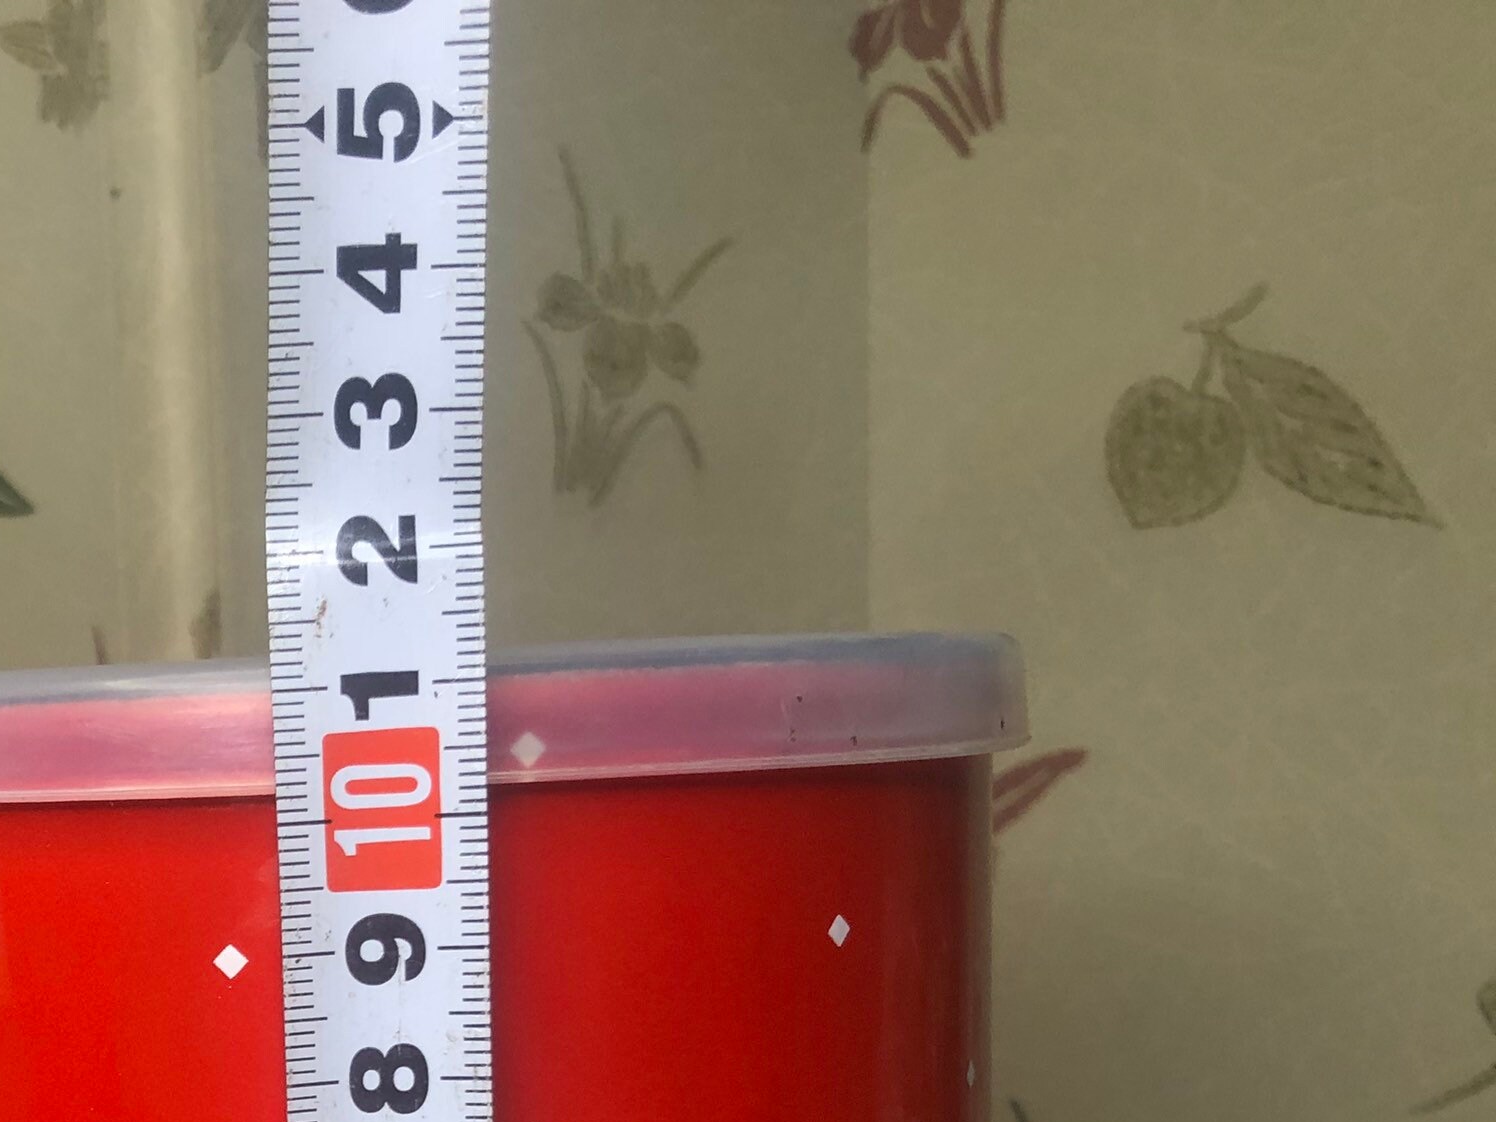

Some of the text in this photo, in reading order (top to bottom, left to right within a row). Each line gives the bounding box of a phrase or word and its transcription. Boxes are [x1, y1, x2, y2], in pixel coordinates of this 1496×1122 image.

[336, 81, 421, 163] 5
[335, 232, 419, 315] 4
[333, 372, 419, 451] 3
[335, 514, 419, 587] 2
[339, 669, 420, 722] 1
[329, 762, 432, 857] 10
[344, 912, 427, 986] 9
[348, 1042, 430, 1115] 8
